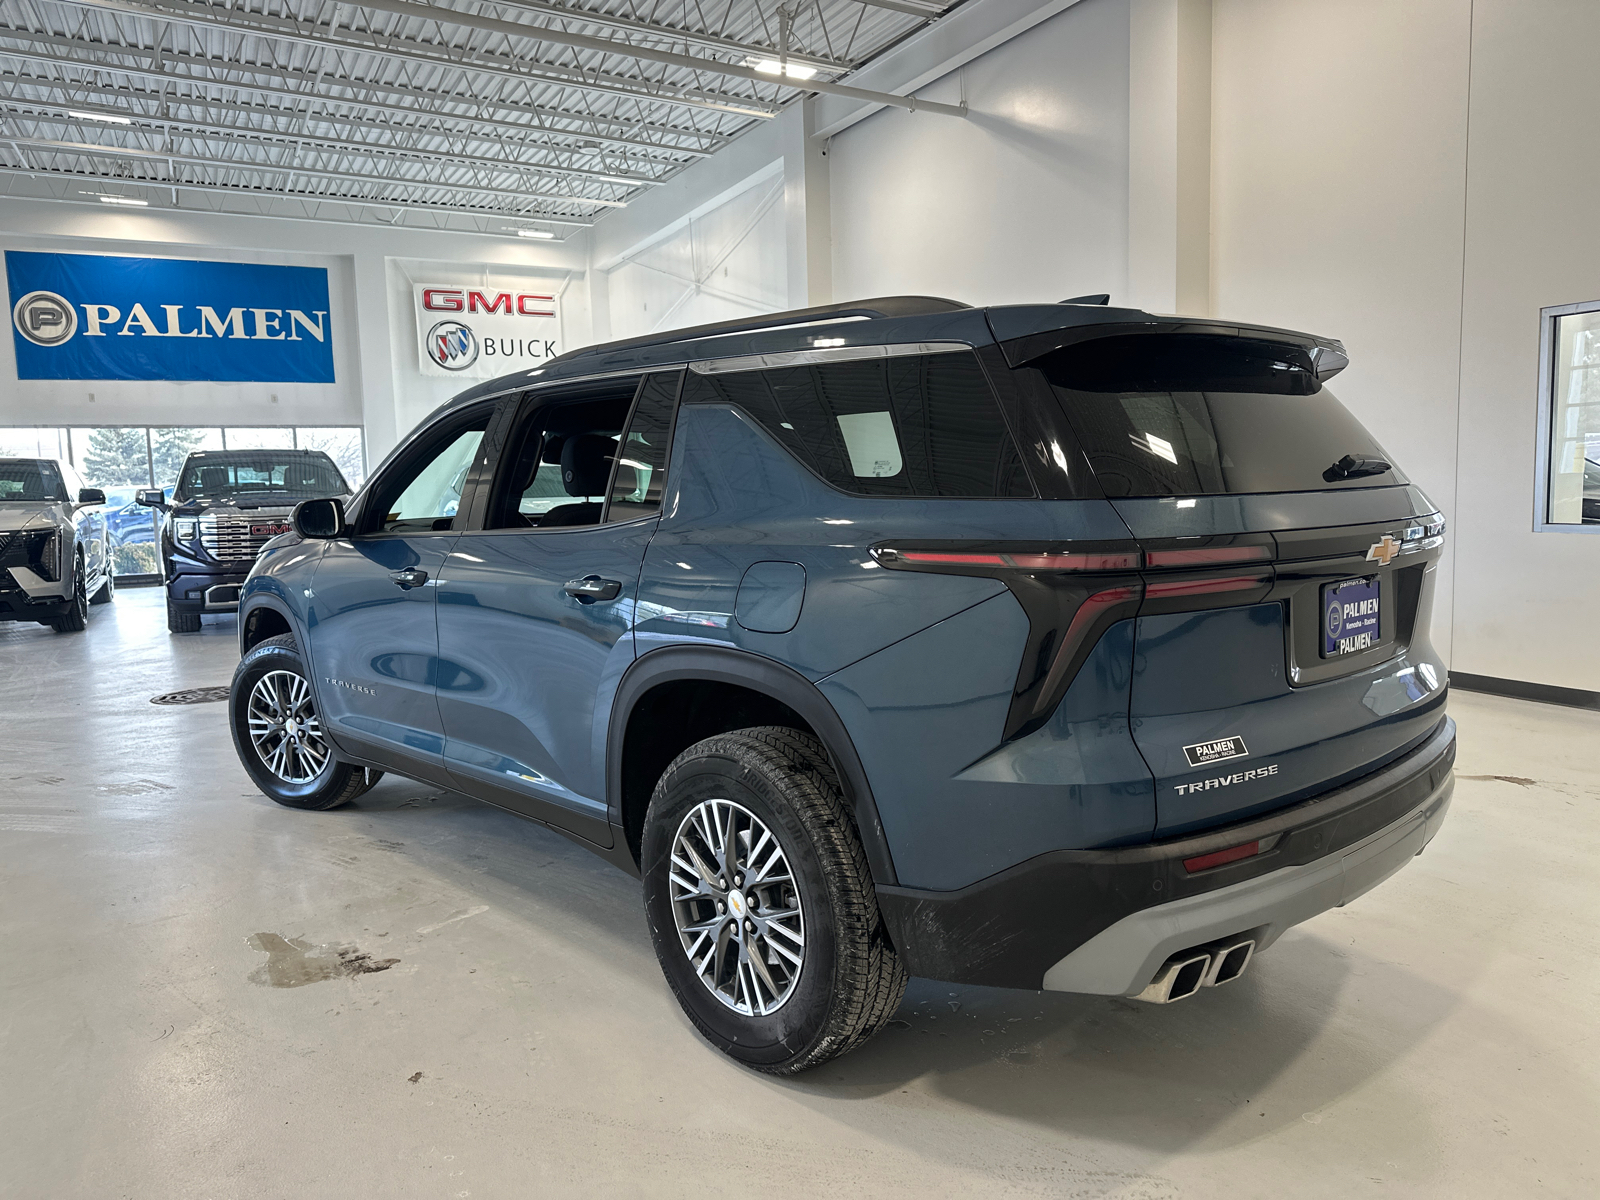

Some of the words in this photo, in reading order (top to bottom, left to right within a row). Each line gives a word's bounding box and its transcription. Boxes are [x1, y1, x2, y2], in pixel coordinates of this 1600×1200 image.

[422, 287, 556, 318] GMC
[80, 302, 328, 343] PALMEN
[484, 337, 557, 359] BUICK
[252, 524, 293, 535] GM
[1343, 597, 1379, 620] PALMEN
[1346, 620, 1362, 630] Kenosha
[1364, 617, 1377, 626] Racine
[1340, 632, 1371, 655] PALMEN
[325, 677, 378, 697] TRAVERSE
[1195, 740, 1235, 757] PALMEN
[1200, 753, 1220, 762] KENOSHA
[1221, 749, 1237, 757] RACINE
[1173, 764, 1279, 797] TRAVERSE
